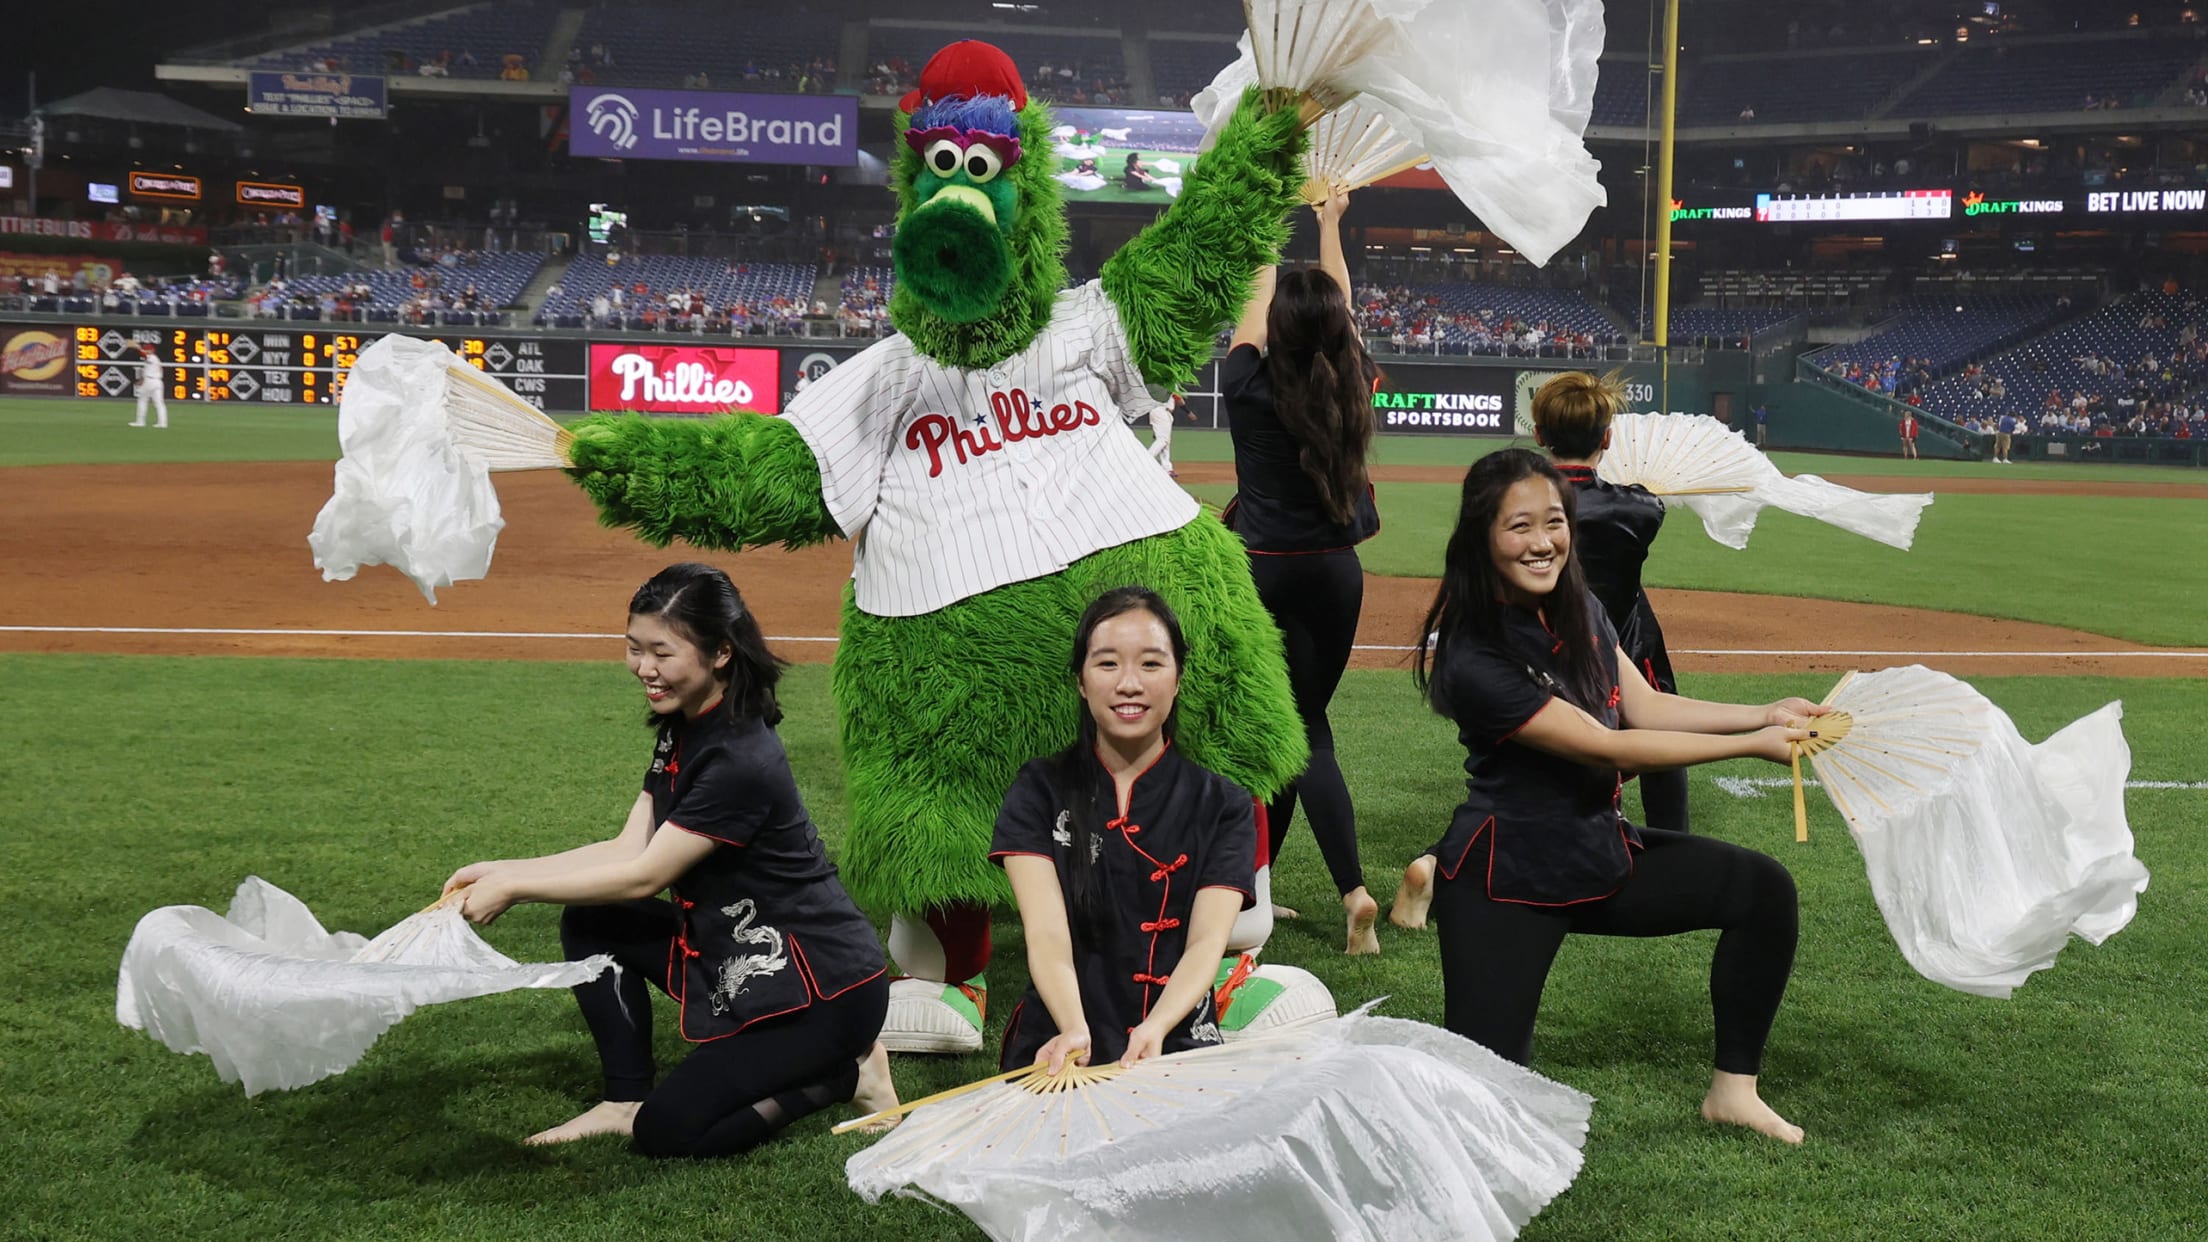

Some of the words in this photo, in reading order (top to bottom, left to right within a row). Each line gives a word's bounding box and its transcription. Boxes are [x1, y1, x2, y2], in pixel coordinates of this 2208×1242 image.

[653, 107, 842, 147] LifeBrand
[1965, 201, 2063, 216] DRAFTKINGS
[2087, 192, 2119, 212] BET
[2123, 191, 2158, 212] LIVE
[2162, 190, 2206, 211] NOW
[1670, 207, 1751, 222] DRAFTKINGS
[132, 330, 162, 344] BOS
[174, 331, 186, 345] 2
[208, 333, 229, 346] 41
[263, 335, 290, 347] MIN
[336, 336, 357, 350] 57
[77, 345, 99, 359] 30
[174, 349, 186, 362] 5
[464, 340, 484, 354] 30
[518, 342, 543, 356] ATL
[208, 350, 229, 364] 45
[262, 352, 290, 365] NYY
[516, 359, 544, 373] OAK
[174, 368, 186, 382] 3
[208, 369, 229, 382] 49
[263, 371, 290, 384] TEX
[611, 353, 753, 404] Phillies
[515, 378, 546, 392] CWS
[208, 387, 229, 400] 59
[262, 388, 292, 402] HOU
[1625, 384, 1653, 402] 330
[1371, 392, 1502, 410] RAFTKINGS
[1387, 411, 1500, 427] SPORTSBOOK
[905, 388, 1100, 478] Phillies
